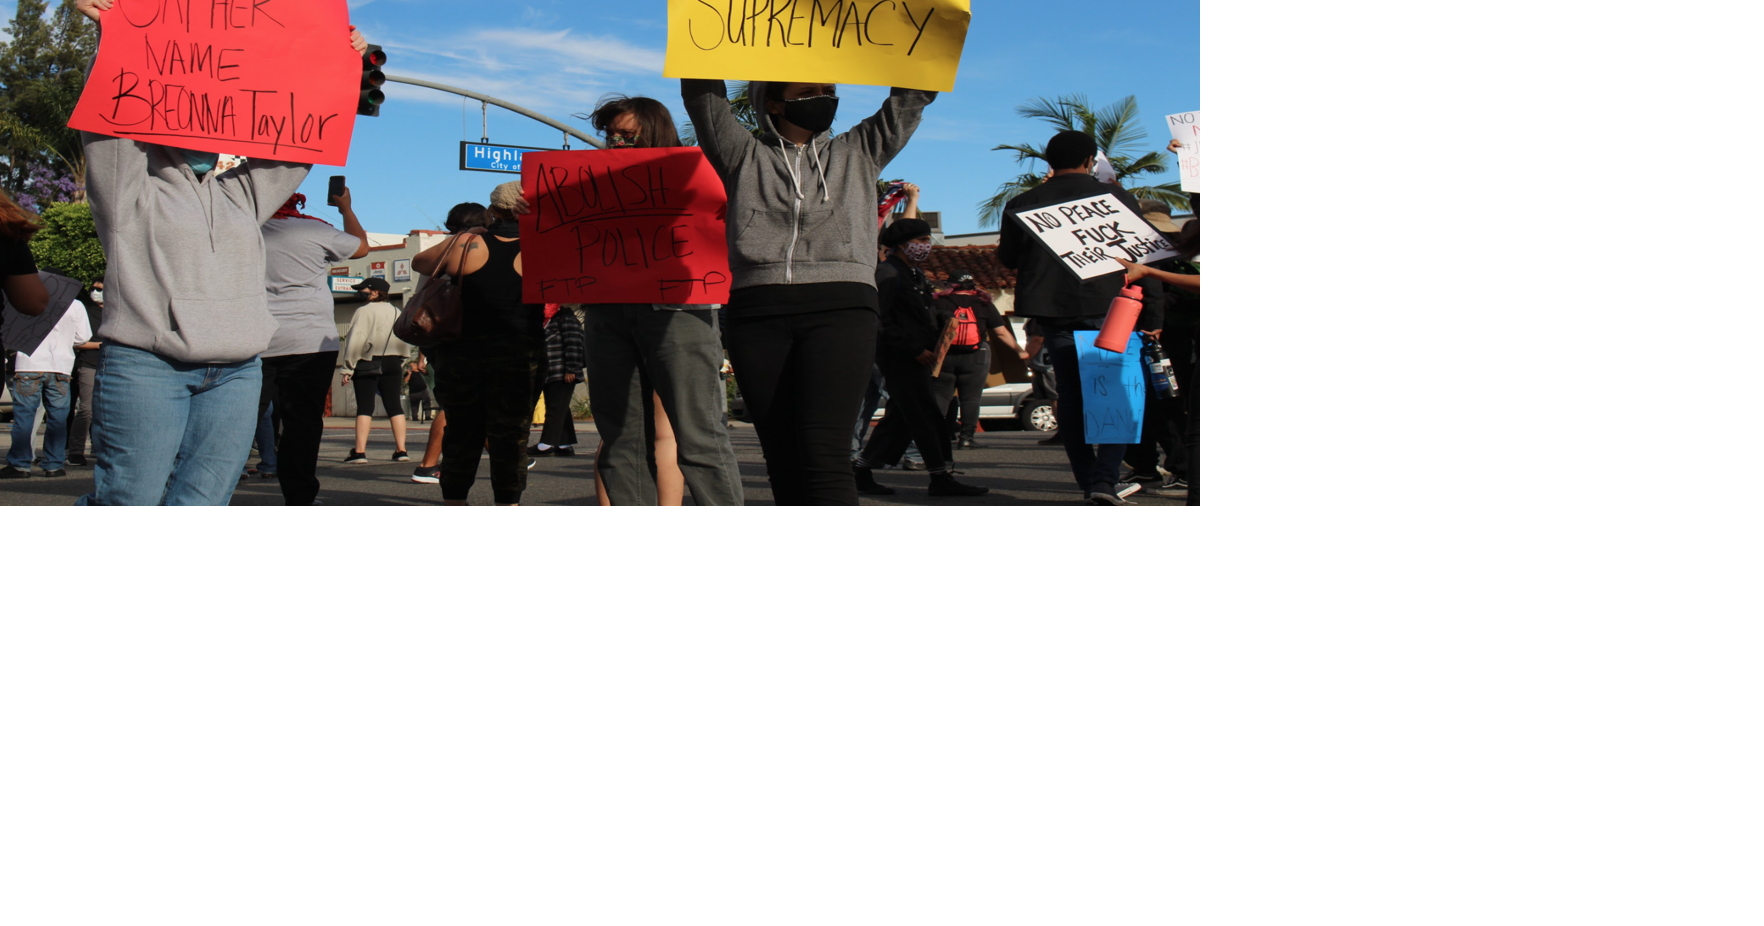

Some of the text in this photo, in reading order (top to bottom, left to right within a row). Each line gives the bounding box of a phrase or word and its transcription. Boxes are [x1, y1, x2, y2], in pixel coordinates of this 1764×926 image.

[689, 0, 935, 56] SUPREMACY
[145, 33, 244, 82] NAME
[99, 67, 338, 155] BREONNA Taylor
[1169, 112, 1195, 126] NO
[490, 161, 509, 171] City
[536, 163, 669, 232] ABOLISH
[1026, 199, 1120, 234] NO PEACE
[571, 224, 694, 273] POLICE
[1071, 221, 1136, 246] FUCK
[537, 271, 726, 300] FTP FTP
